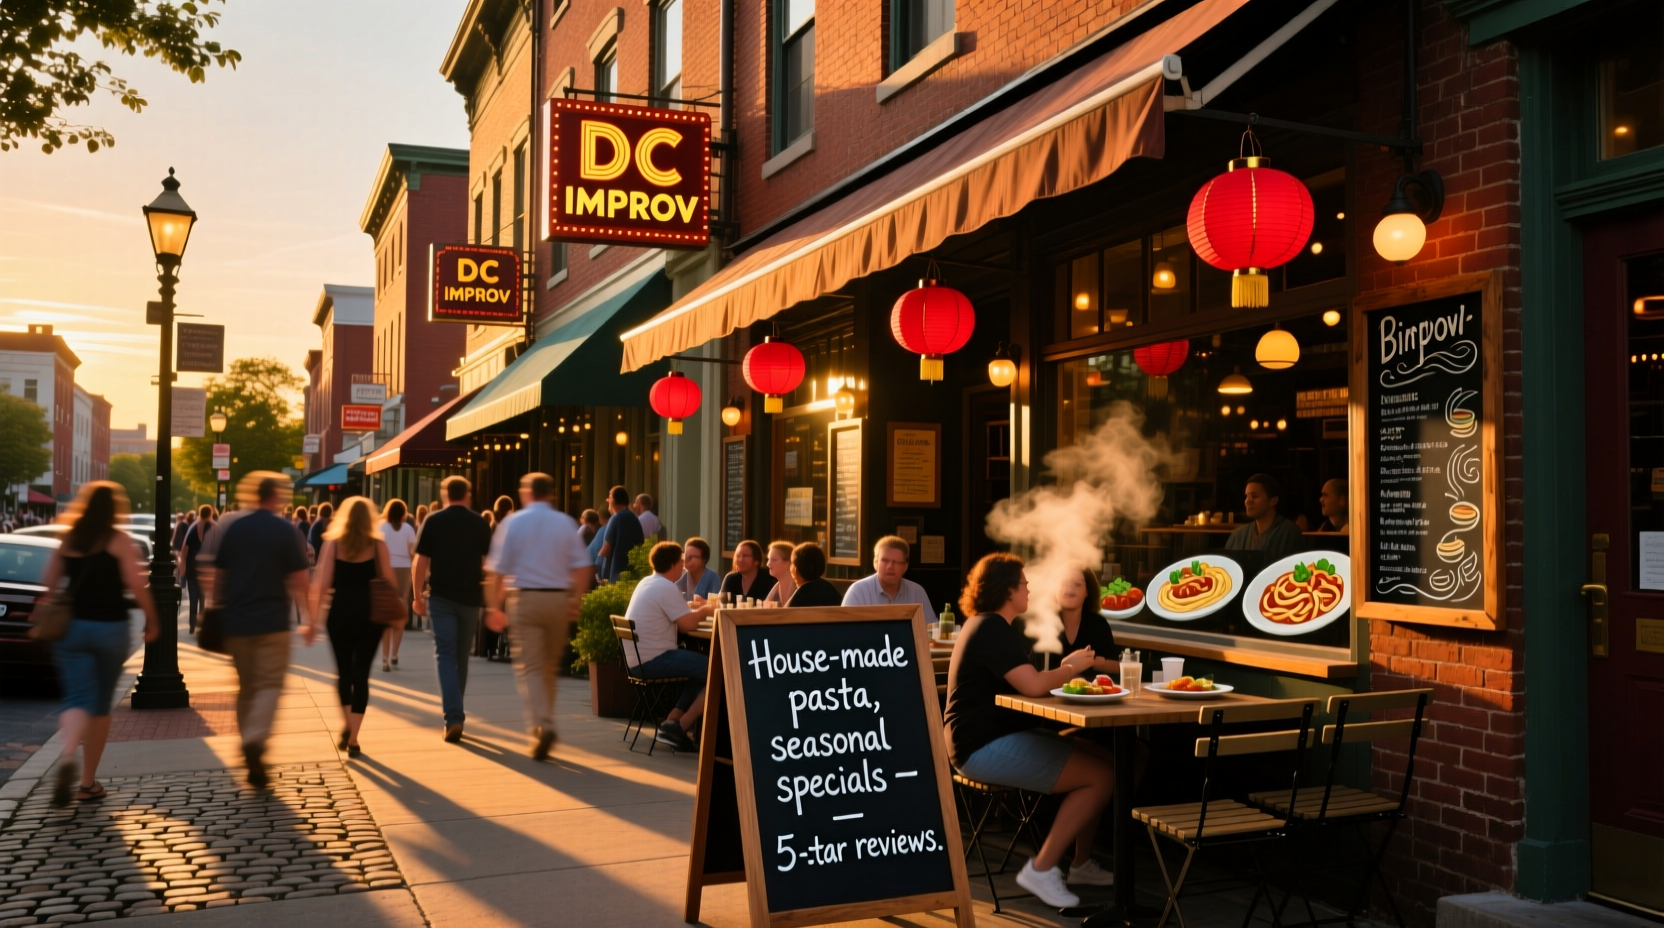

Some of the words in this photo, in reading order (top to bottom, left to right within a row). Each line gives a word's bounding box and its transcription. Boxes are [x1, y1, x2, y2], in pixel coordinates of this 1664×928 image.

[580, 119, 684, 187] DC
[565, 185, 699, 224] IMPROV
[457, 258, 499, 284] DC
[444, 286, 511, 304] IMPROV
[748, 633, 908, 679] House-made
[788, 677, 880, 729] pasta,
[771, 716, 892, 761] seasonal
[777, 758, 887, 815] specials
[855, 829, 944, 860] reviews.
